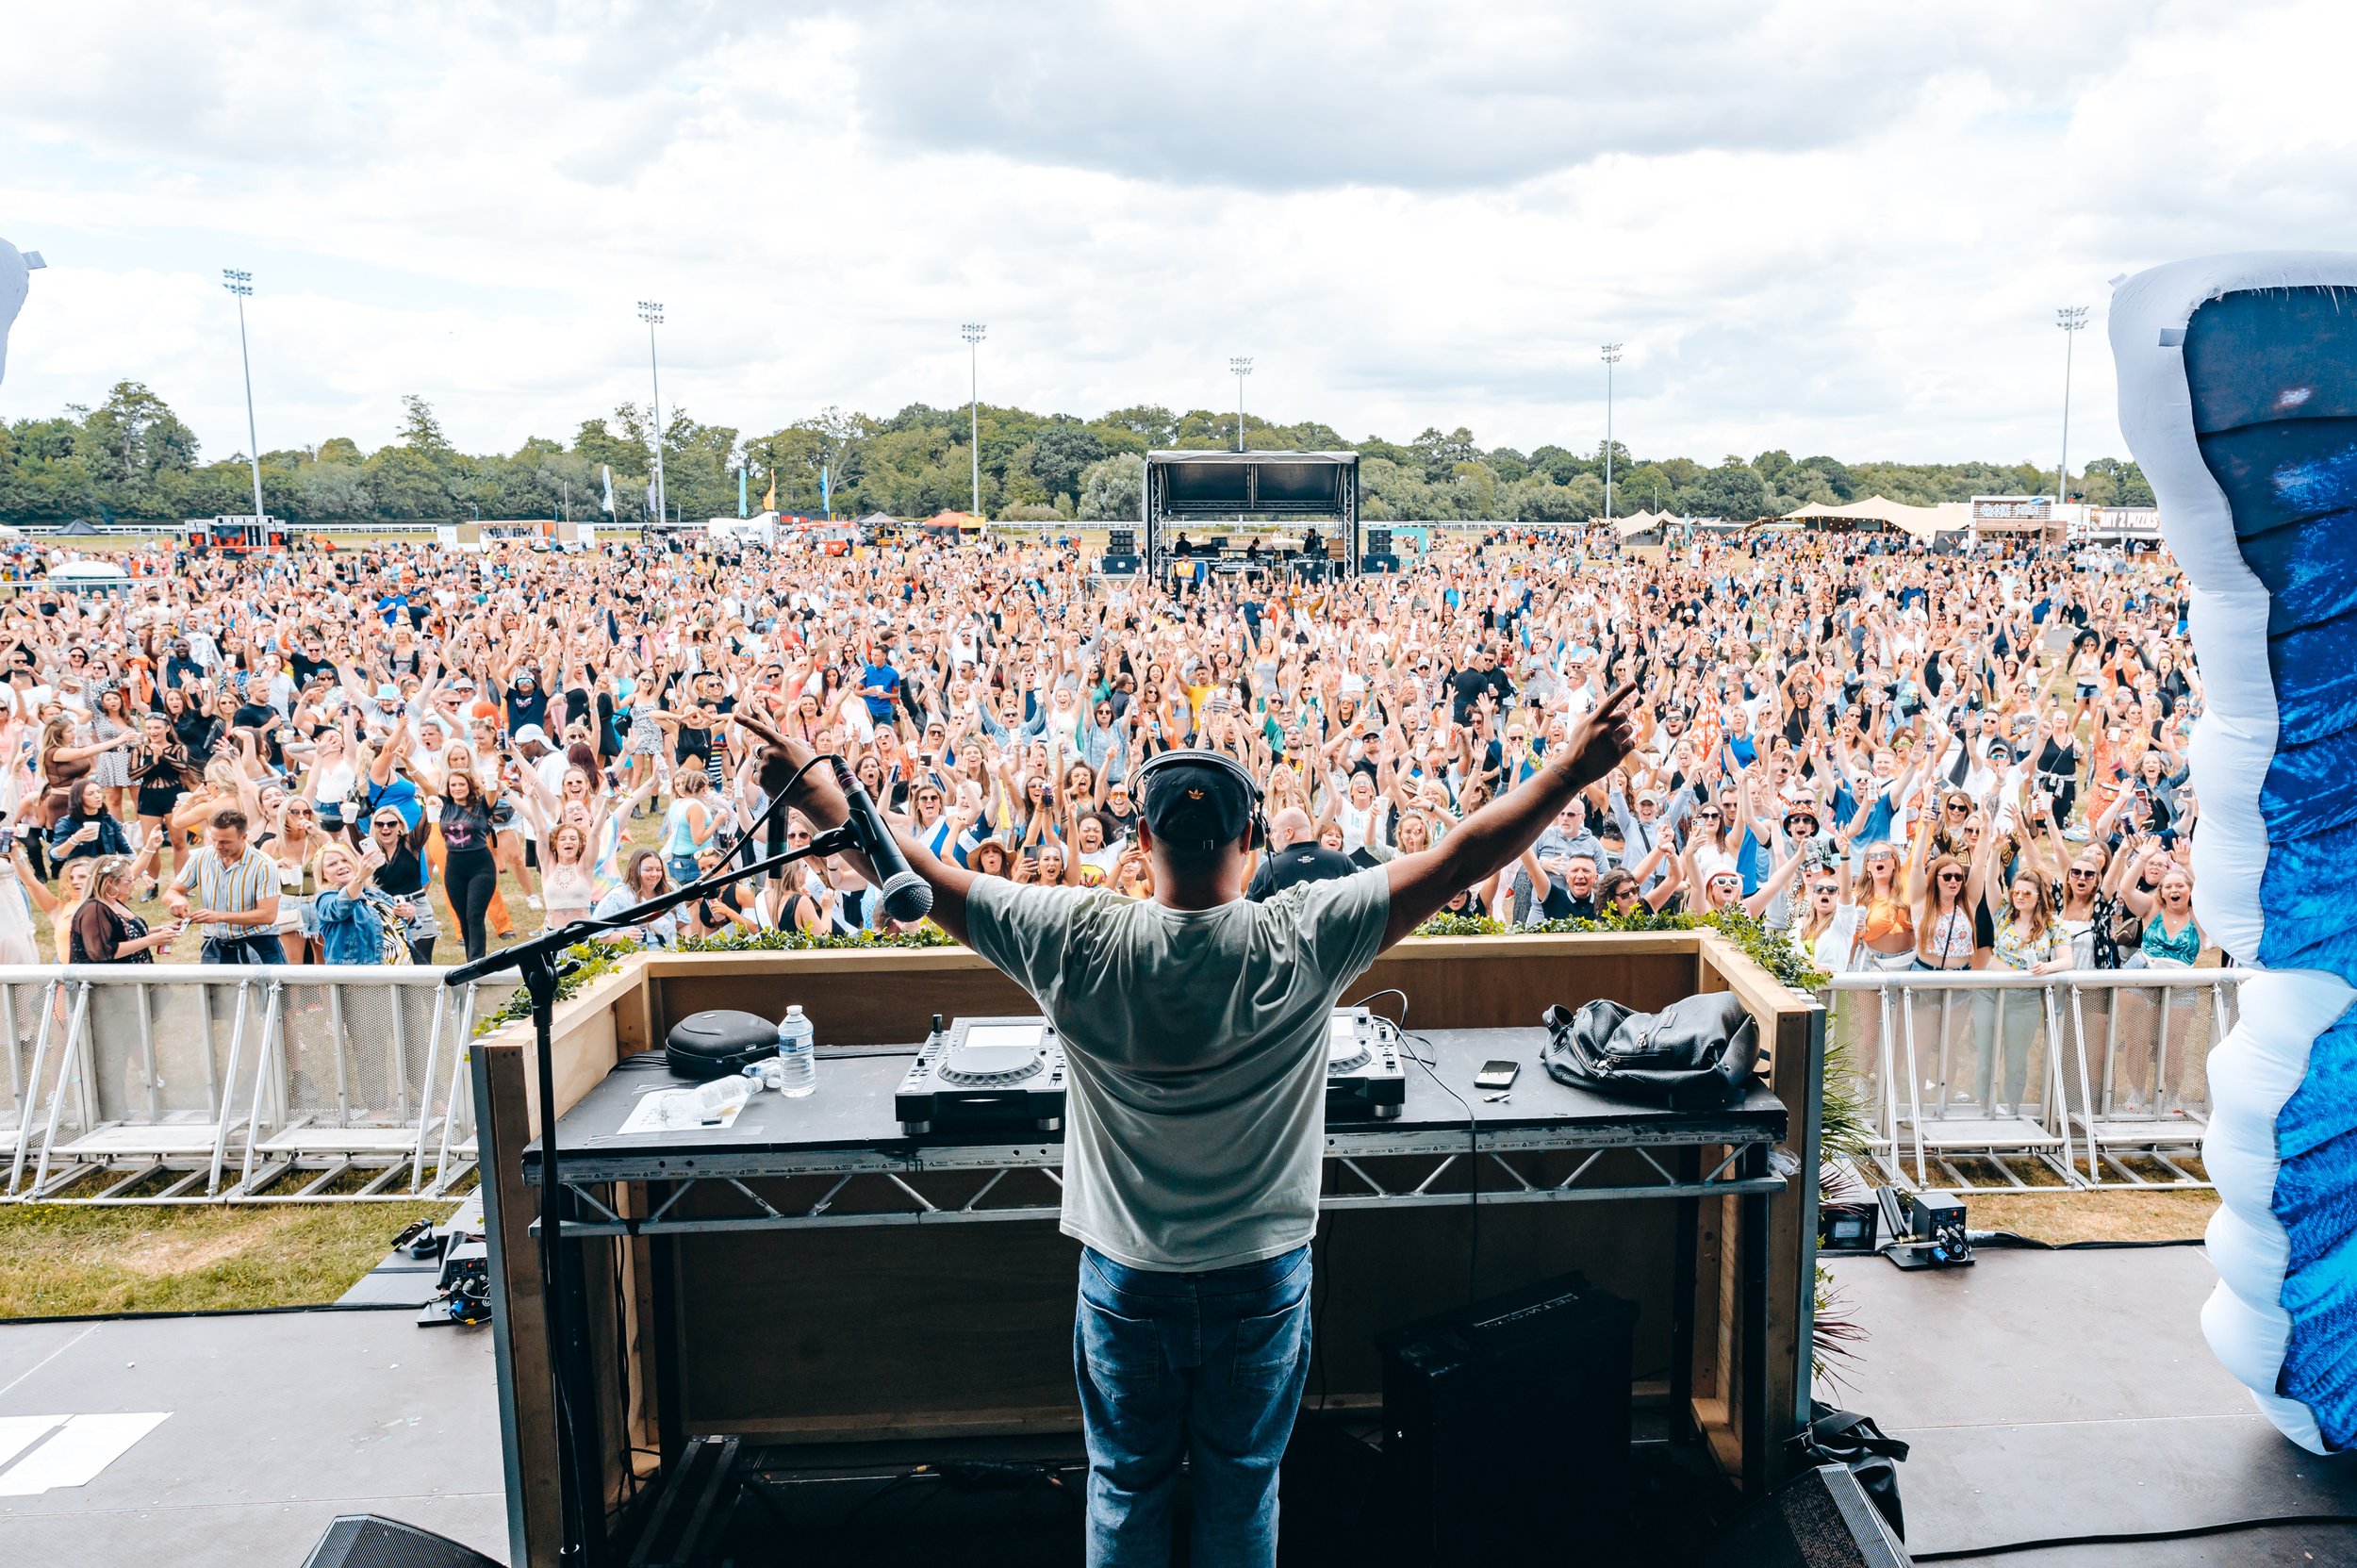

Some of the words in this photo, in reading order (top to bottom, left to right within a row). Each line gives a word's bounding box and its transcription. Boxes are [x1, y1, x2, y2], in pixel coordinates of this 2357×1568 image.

[2100, 512, 2118, 528] ANY
[2118, 512, 2126, 528] 2
[2127, 512, 2158, 528] PIZZAS
